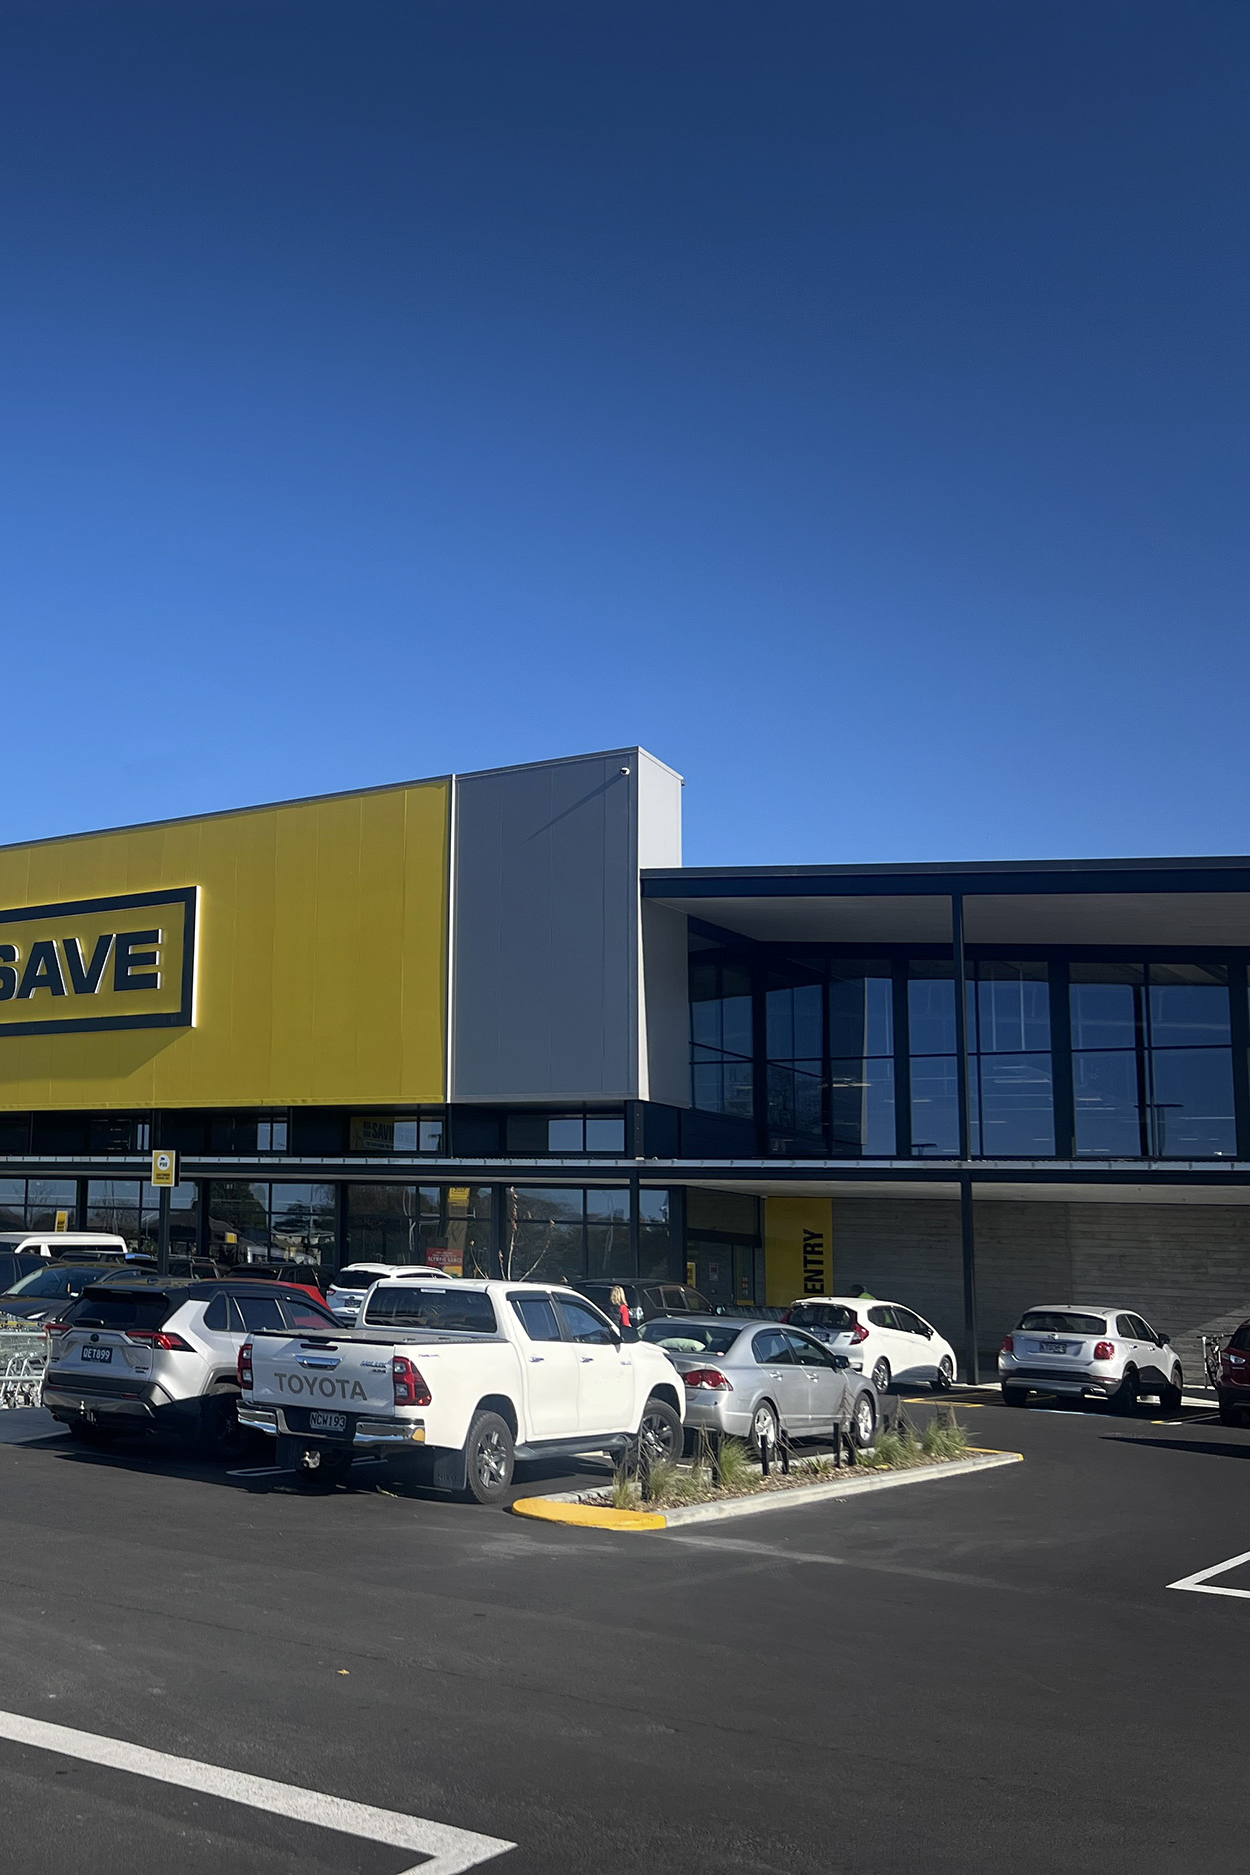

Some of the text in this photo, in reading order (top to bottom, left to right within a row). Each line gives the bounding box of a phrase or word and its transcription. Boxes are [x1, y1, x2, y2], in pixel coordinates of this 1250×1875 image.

[803, 1228, 824, 1294] ENTRY
[274, 1372, 367, 1401] TOYOTA
[310, 1412, 346, 1428] NCW193
